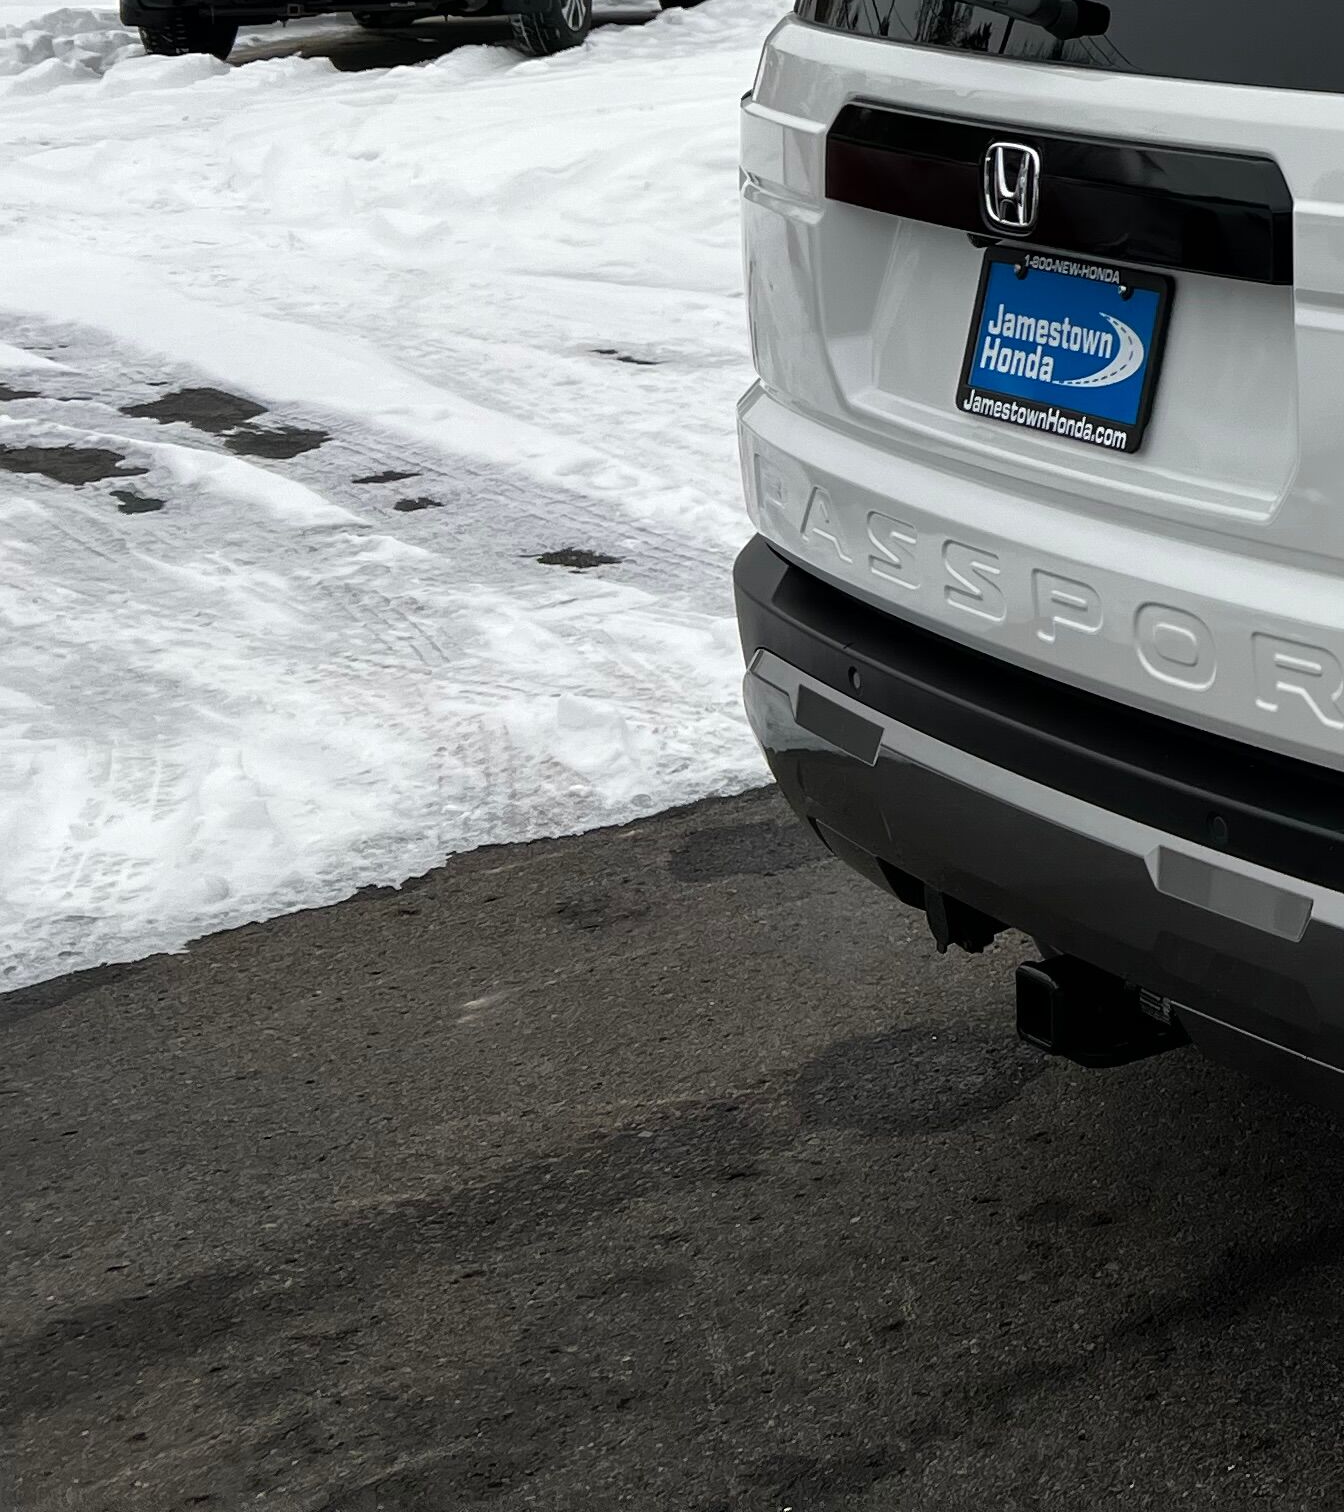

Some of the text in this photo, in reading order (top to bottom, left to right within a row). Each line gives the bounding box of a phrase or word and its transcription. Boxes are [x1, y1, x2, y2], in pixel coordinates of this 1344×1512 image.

[1024, 254, 1121, 285] 1-800-NEW-HONDA
[988, 303, 1114, 359] Jamestown
[979, 335, 1054, 383] Honda
[963, 389, 1128, 450] JamestownHonda.com
